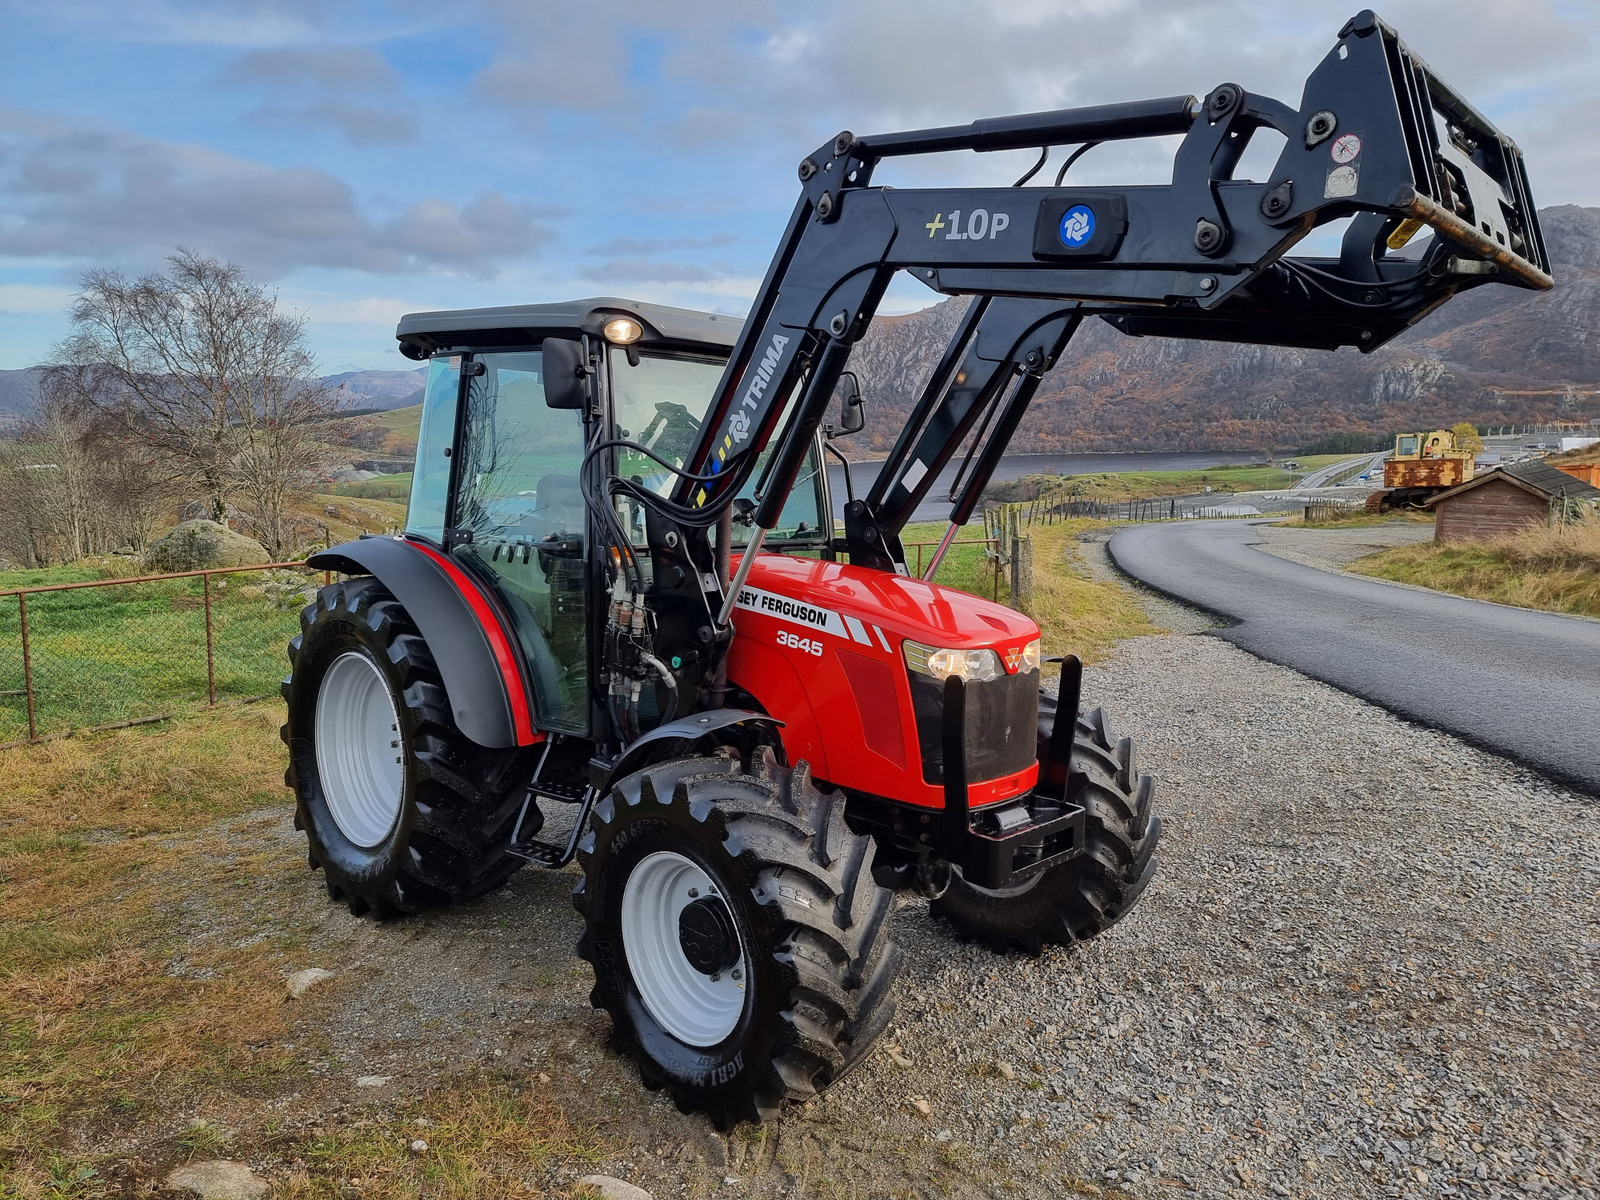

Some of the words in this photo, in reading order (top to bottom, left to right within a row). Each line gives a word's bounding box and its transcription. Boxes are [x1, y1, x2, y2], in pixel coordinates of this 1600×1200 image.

[741, 333, 790, 411] TRIMA
[761, 596, 828, 627] FERGUSON
[776, 630, 824, 657] 3645
